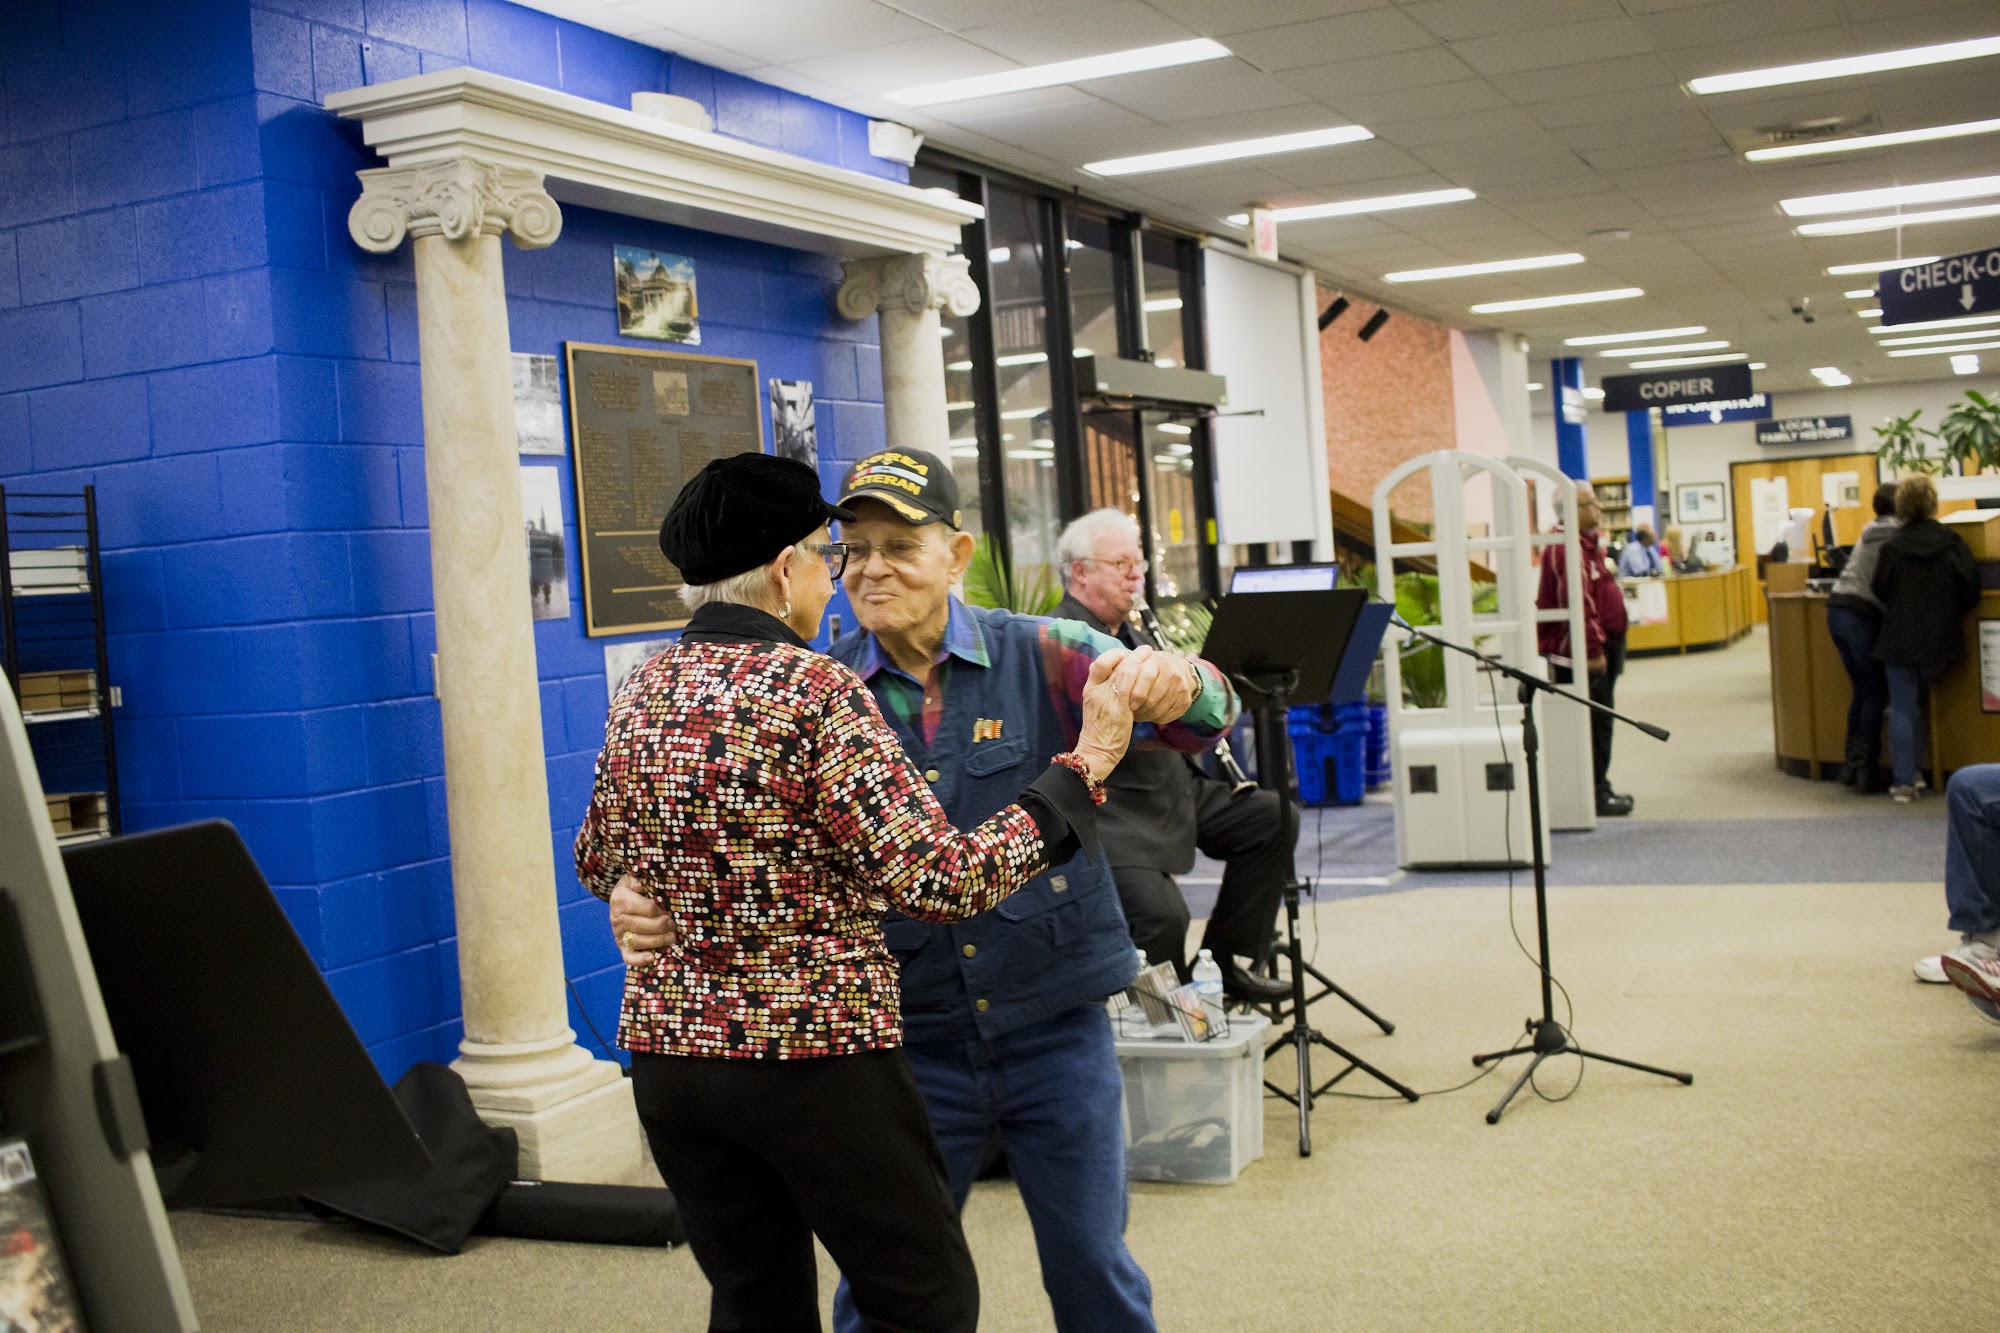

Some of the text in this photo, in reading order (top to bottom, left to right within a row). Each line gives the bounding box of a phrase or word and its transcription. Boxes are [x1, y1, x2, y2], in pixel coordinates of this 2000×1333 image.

[1639, 377, 1713, 399] COPIER
[1760, 426, 1847, 443] FAMILY HISTORY
[1779, 419, 1815, 432] LOCAL
[855, 452, 928, 476] KOREA
[848, 474, 922, 496] VETERAN
